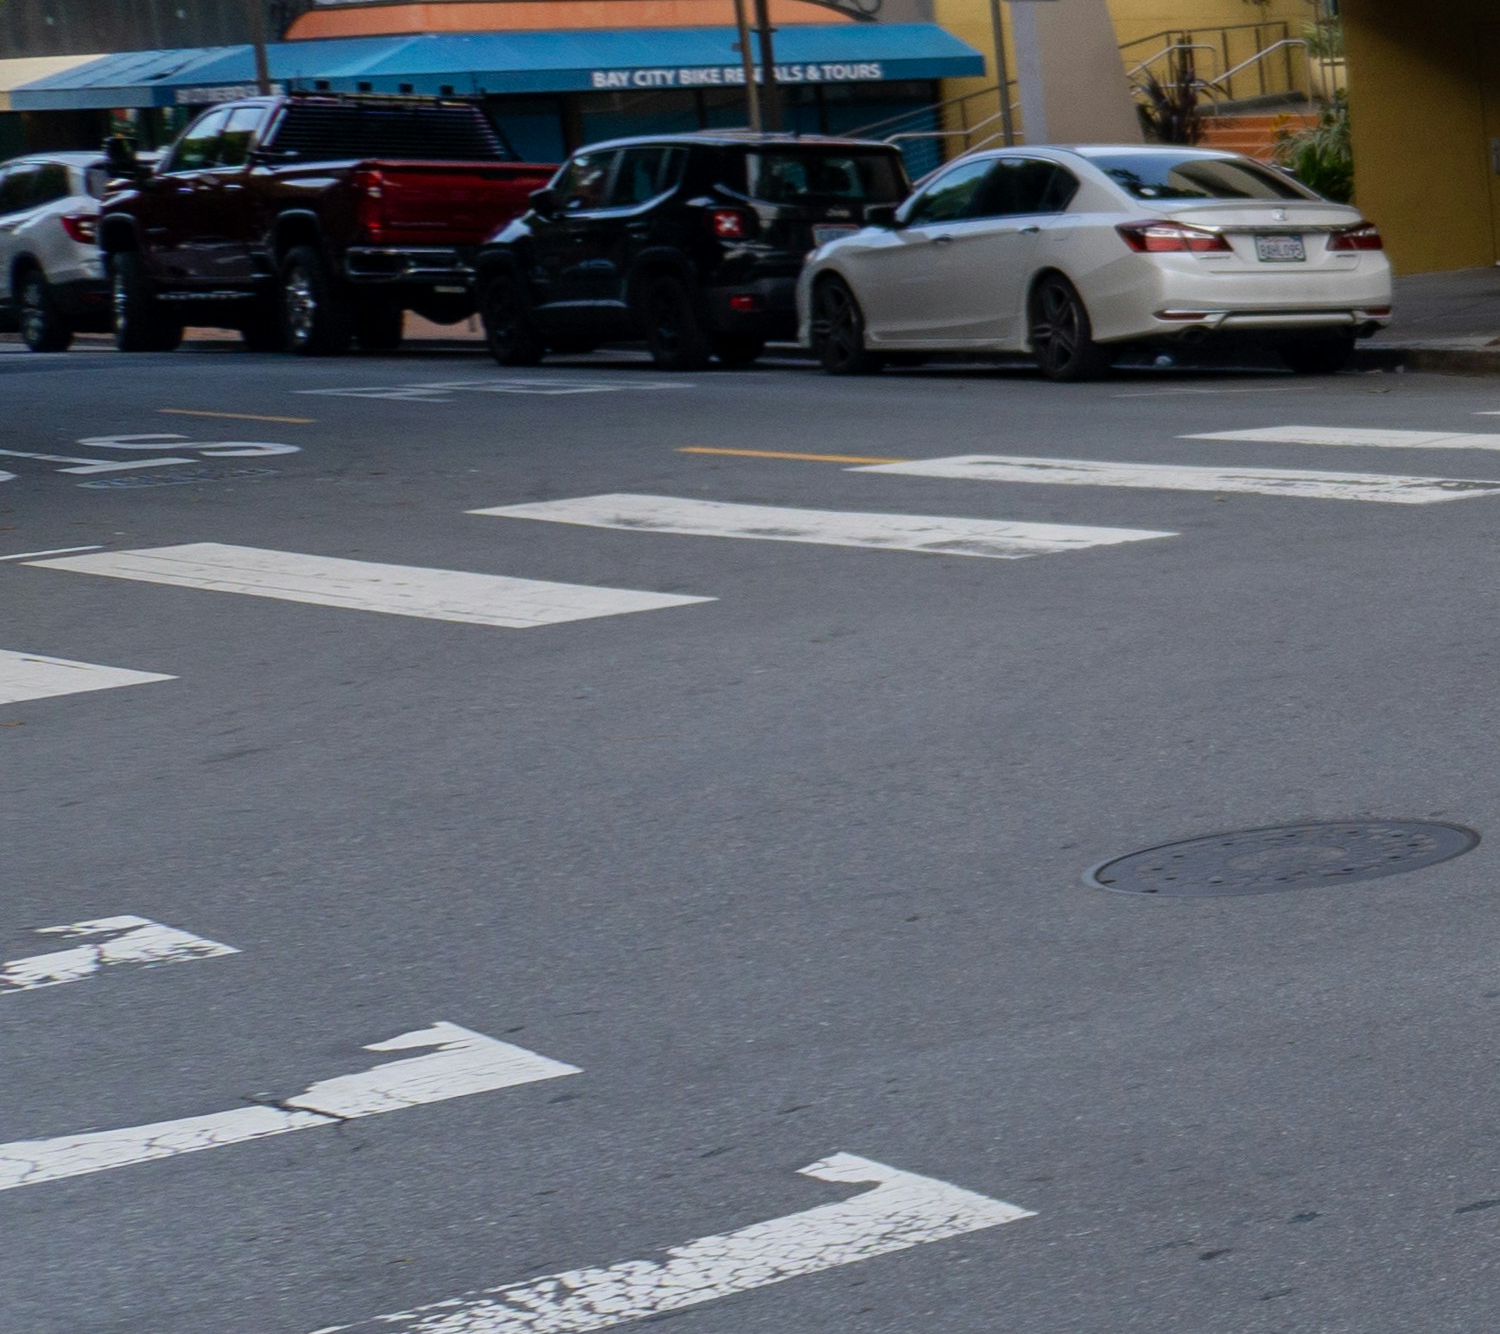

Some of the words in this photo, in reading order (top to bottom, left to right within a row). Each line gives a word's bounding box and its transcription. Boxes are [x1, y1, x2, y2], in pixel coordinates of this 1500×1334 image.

[592, 68, 620, 88] BAY
[623, 67, 675, 87] CITY
[678, 66, 721, 86] BIKE
[724, 64, 801, 85] RENALS
[806, 66, 821, 81] &
[823, 63, 881, 82] TOURS
